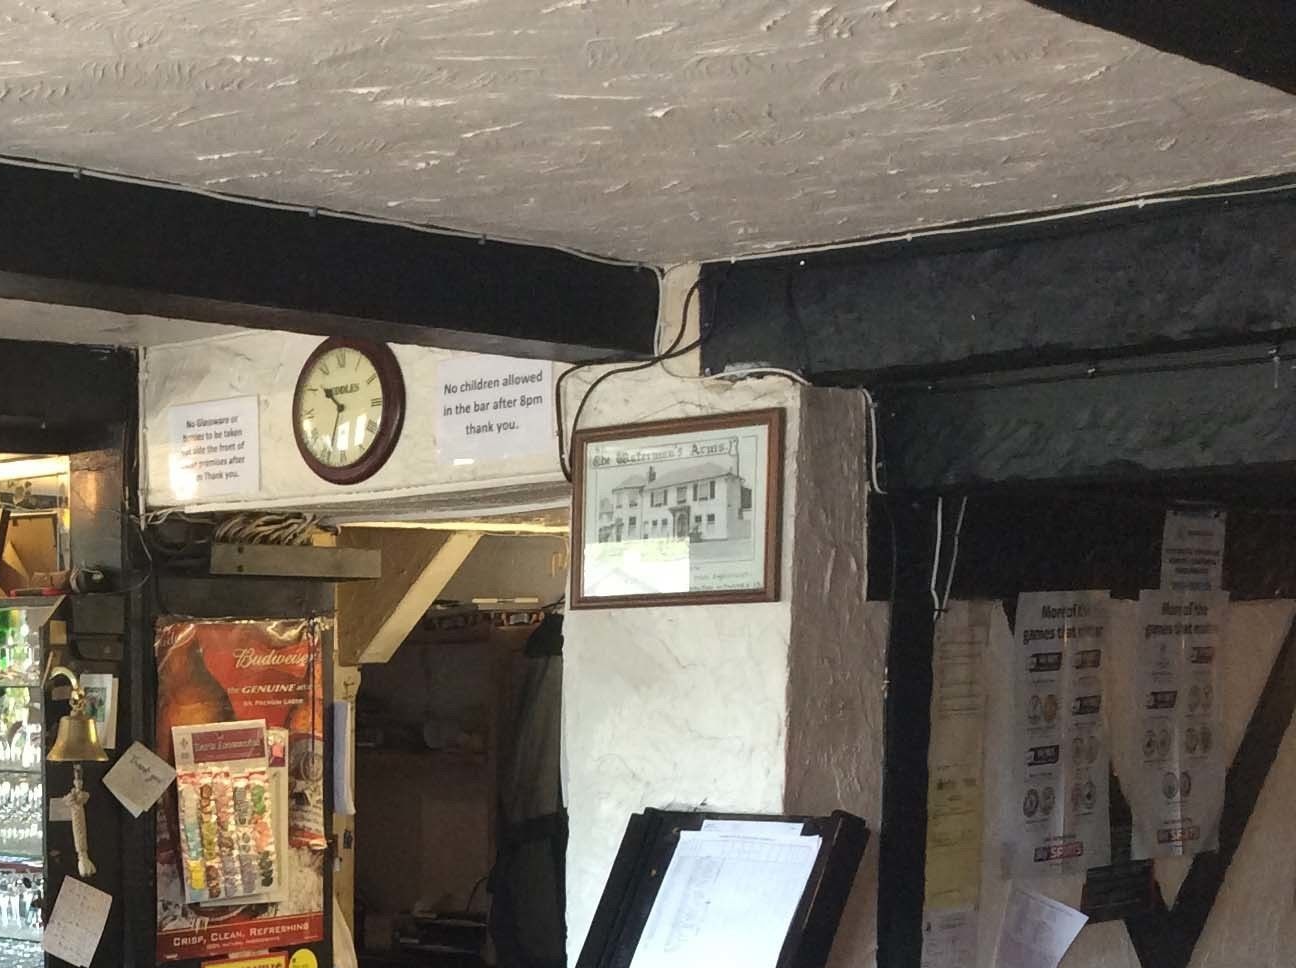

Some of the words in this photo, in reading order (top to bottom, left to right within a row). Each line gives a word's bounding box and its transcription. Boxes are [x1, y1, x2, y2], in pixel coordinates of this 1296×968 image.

[443, 383, 458, 394] No
[460, 378, 500, 393] children
[502, 370, 543, 386] allowed
[443, 405, 452, 416] in
[455, 403, 471, 415] the
[474, 401, 490, 412] bar
[493, 396, 517, 410] after
[520, 394, 543, 408] 8pm
[224, 428, 243, 437] taken
[465, 421, 494, 435] thank
[496, 420, 520, 434] you.
[241, 683, 297, 694] GENUINE
[173, 935, 207, 947] CRISP,
[210, 930, 246, 942] CLEAN,
